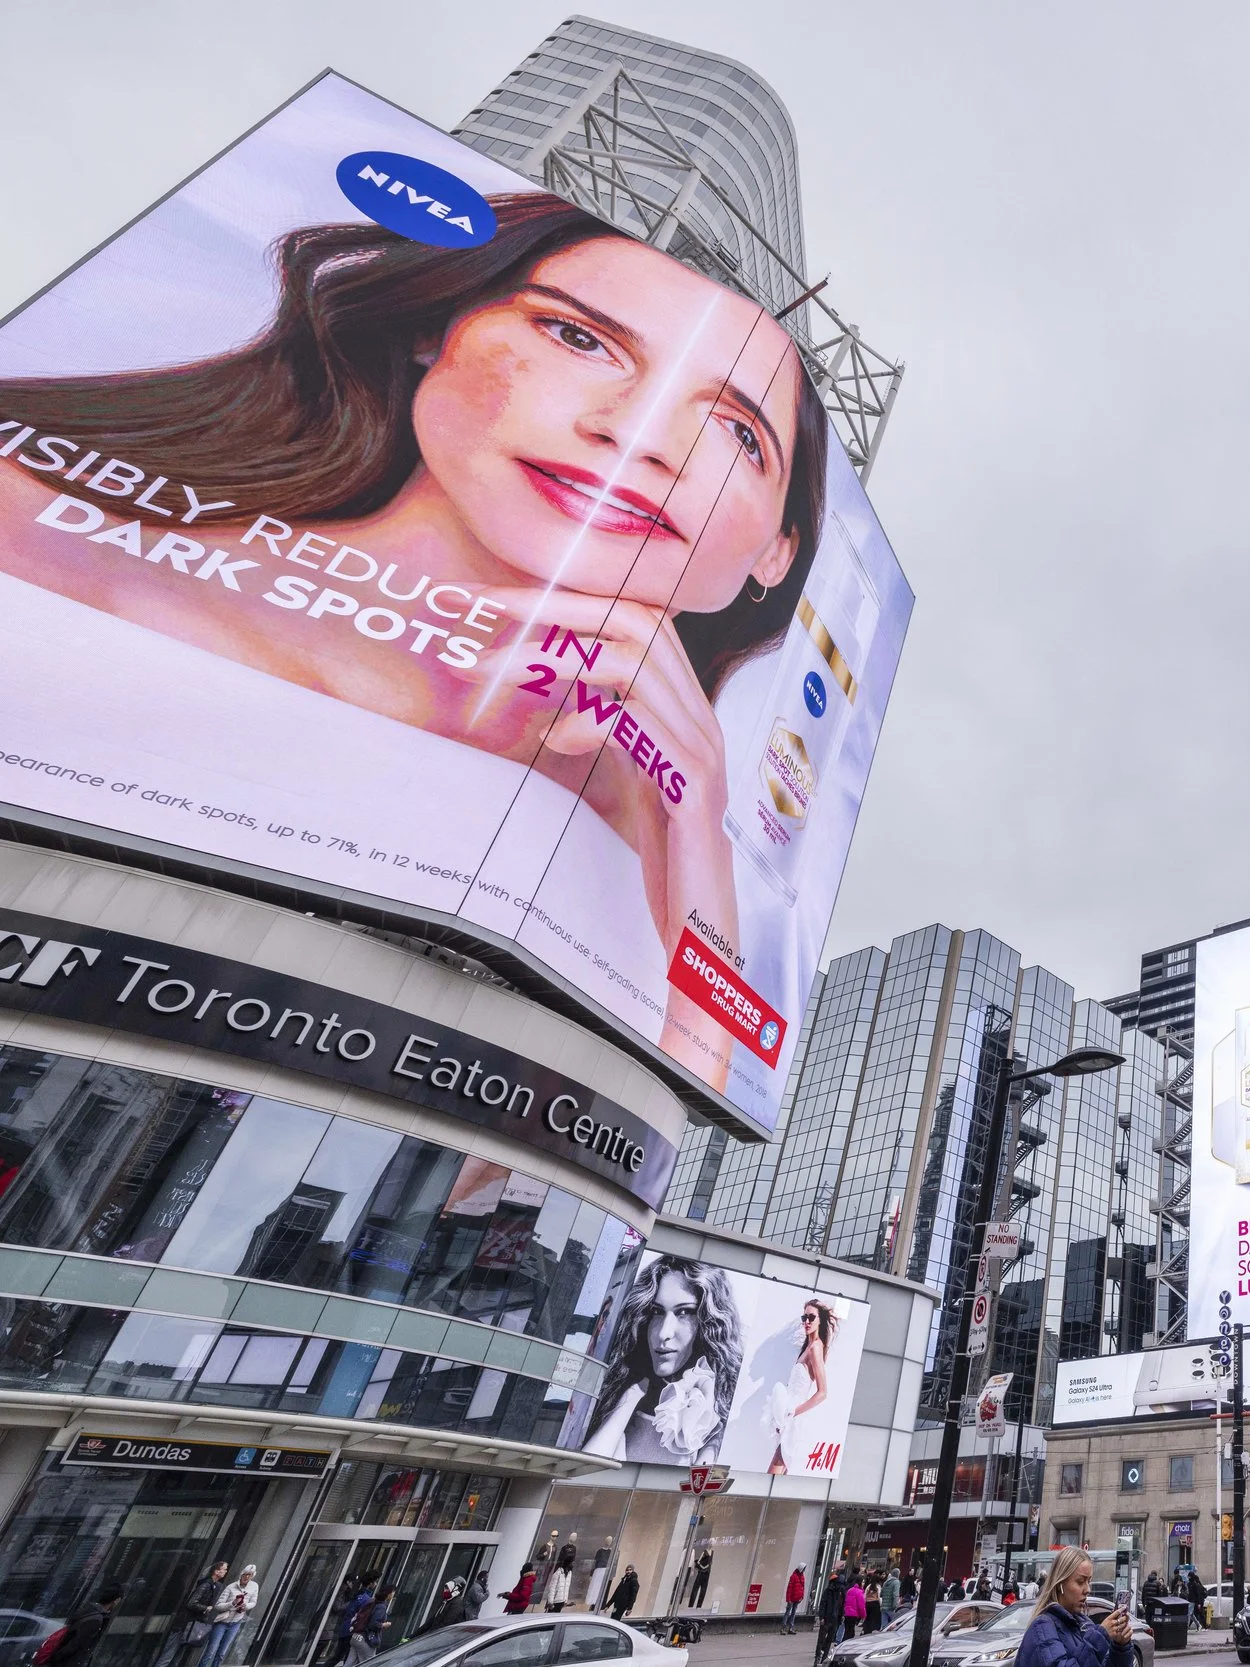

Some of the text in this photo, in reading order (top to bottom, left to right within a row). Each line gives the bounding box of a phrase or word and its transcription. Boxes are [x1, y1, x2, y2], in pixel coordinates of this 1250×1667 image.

[357, 164, 476, 236] NIVEA
[0, 420, 507, 632] ISIBLY REDUCE
[35, 495, 486, 668] DARK SPOTS
[541, 624, 603, 672] IN
[806, 680, 823, 710] NIVEA
[517, 664, 687, 804] 2 WEEKS
[111, 781, 139, 795] of
[141, 790, 193, 812] dark
[198, 804, 259, 831] spots,
[267, 822, 295, 838] up
[300, 830, 321, 844] to
[330, 837, 361, 857] 71%,
[368, 848, 388, 862] in
[392, 855, 411, 868] 12
[416, 862, 472, 884] weeks
[478, 880, 510, 902] with
[514, 897, 572, 944] continuous
[573, 940, 591, 959] use:
[592, 954, 640, 1000] Self-grading
[692, 1033, 711, 1054] study
[688, 908, 746, 971] Available at
[682, 947, 762, 1025] SHOPPERS
[711, 990, 758, 1036] DRUG MART
[115, 955, 376, 1060] Toronto
[392, 1035, 536, 1116] Eaton
[547, 1094, 646, 1173] Centre
[986, 1234, 1018, 1245] STANDING
[998, 1224, 1010, 1234] NO
[1069, 1376, 1097, 1386] SAMSUNG
[112, 1440, 192, 1461] Dundas
[806, 1441, 841, 1473] H&M
[1121, 1526, 1134, 1536] fido
